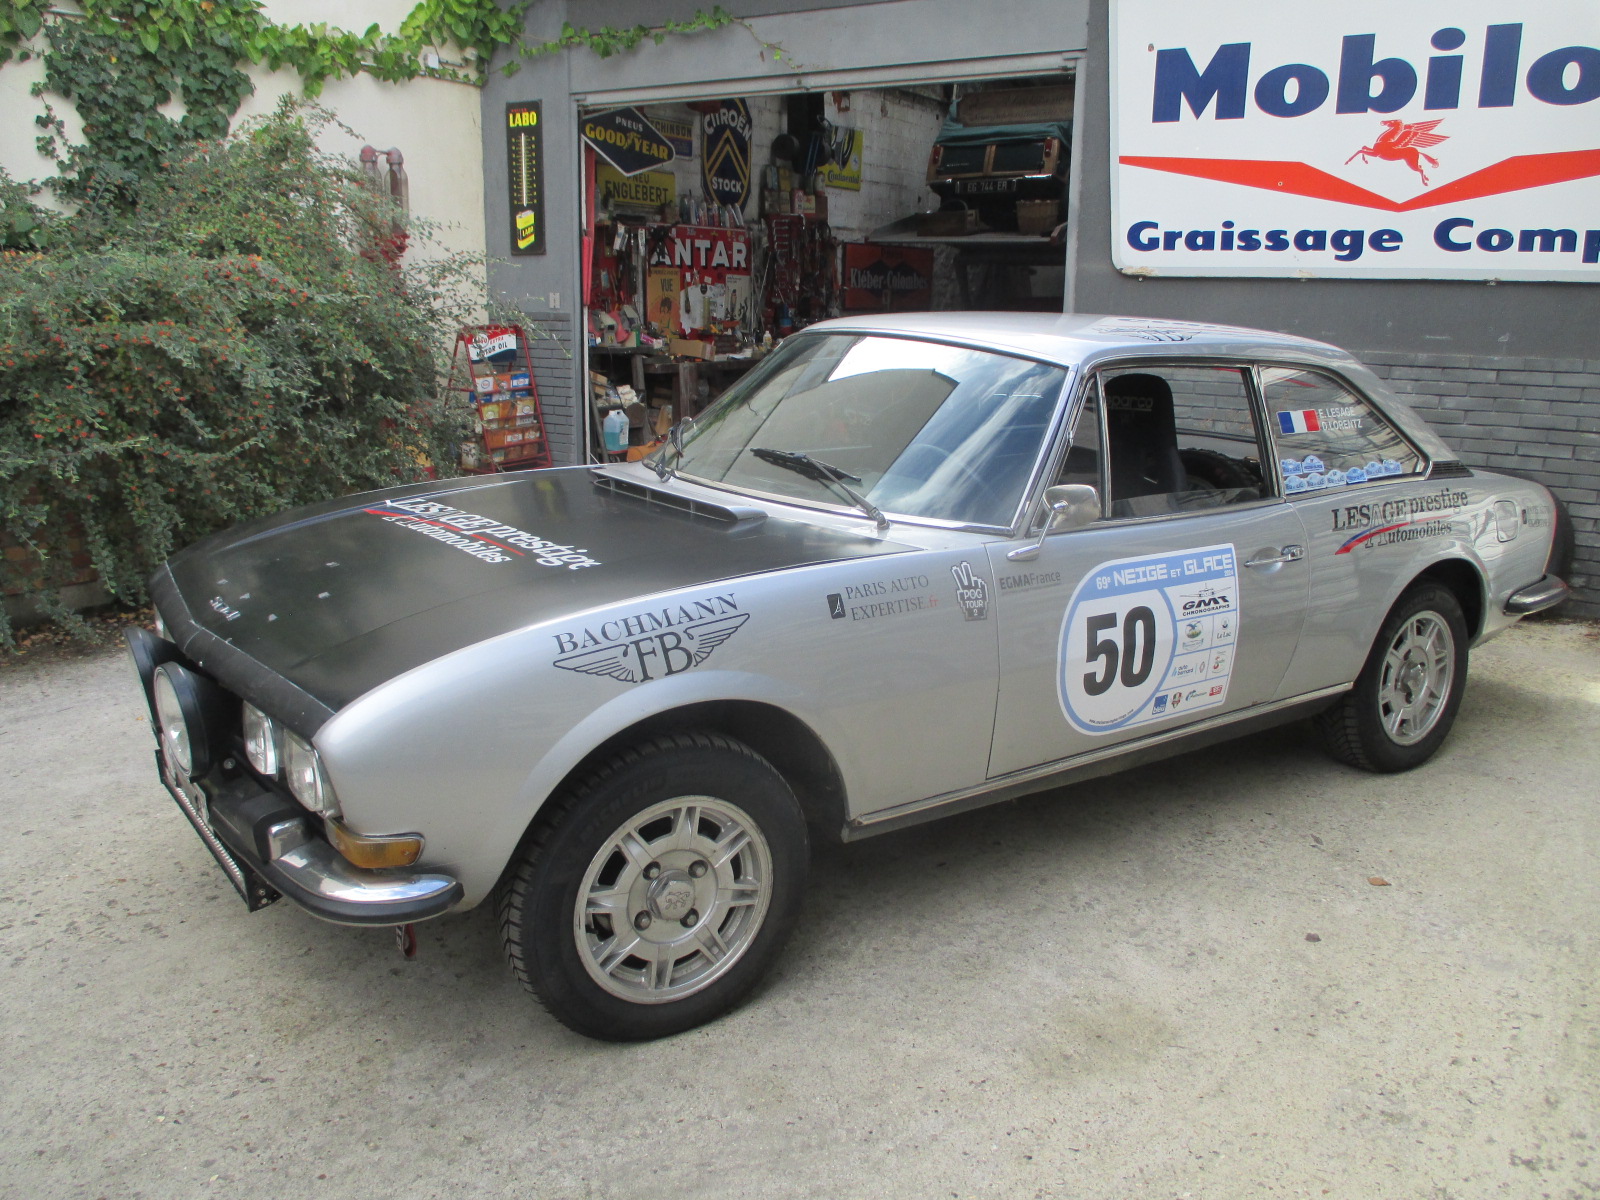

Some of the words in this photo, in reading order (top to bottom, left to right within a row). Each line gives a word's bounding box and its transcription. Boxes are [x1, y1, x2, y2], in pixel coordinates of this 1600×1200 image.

[509, 111, 537, 128] LABO
[615, 115, 644, 133] PNEUS
[711, 176, 743, 193] STOCK
[827, 169, 860, 185] Continental
[604, 179, 669, 204] ENGLEBERT
[1126, 220, 1404, 262] Graissage
[498, 341, 508, 350] OIL
[1331, 499, 1407, 532] LESAGE
[1409, 487, 1469, 525] prestige
[1113, 563, 1168, 587] NEIGE
[1170, 568, 1181, 578] ET
[1183, 553, 1233, 576] GLACE
[844, 580, 888, 600] PARIS
[889, 573, 929, 593] AUTO
[963, 588, 983, 600] POG
[965, 599, 984, 609] TOUR
[1182, 595, 1230, 611] GMT
[1182, 603, 1230, 617] CHRONOGRAPHS
[973, 608, 978, 616] 2
[552, 592, 739, 655] BACHMANN
[629, 630, 693, 683] FB
[1083, 605, 1156, 697] 50
